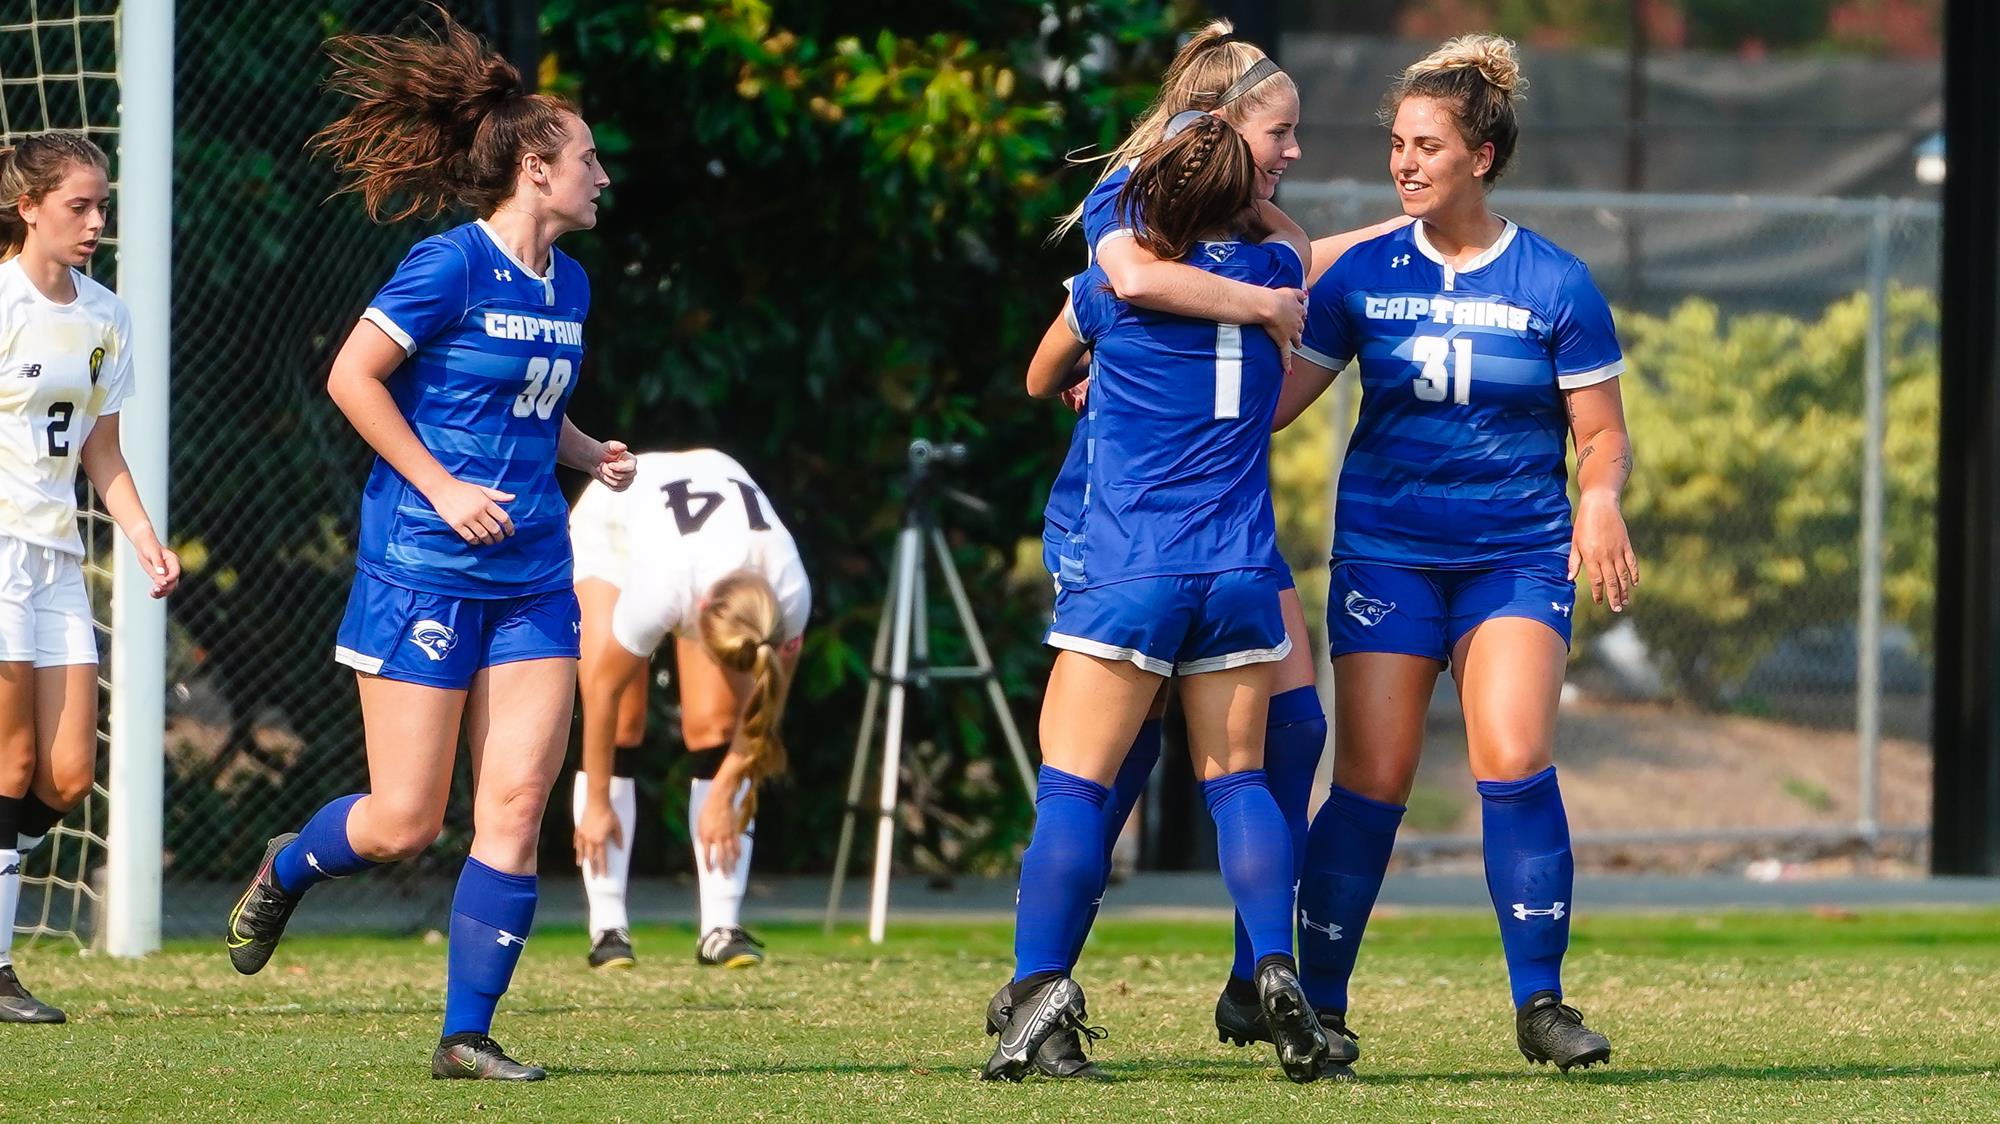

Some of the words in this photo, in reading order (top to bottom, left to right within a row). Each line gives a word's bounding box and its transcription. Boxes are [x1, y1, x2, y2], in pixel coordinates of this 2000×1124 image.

[1365, 296, 1532, 331] CAPTAINS
[512, 356, 572, 420] 38
[1214, 323, 1243, 420] 1
[1412, 335, 1473, 406] 31
[47, 402, 74, 457] 2
[660, 478, 771, 536] 14
